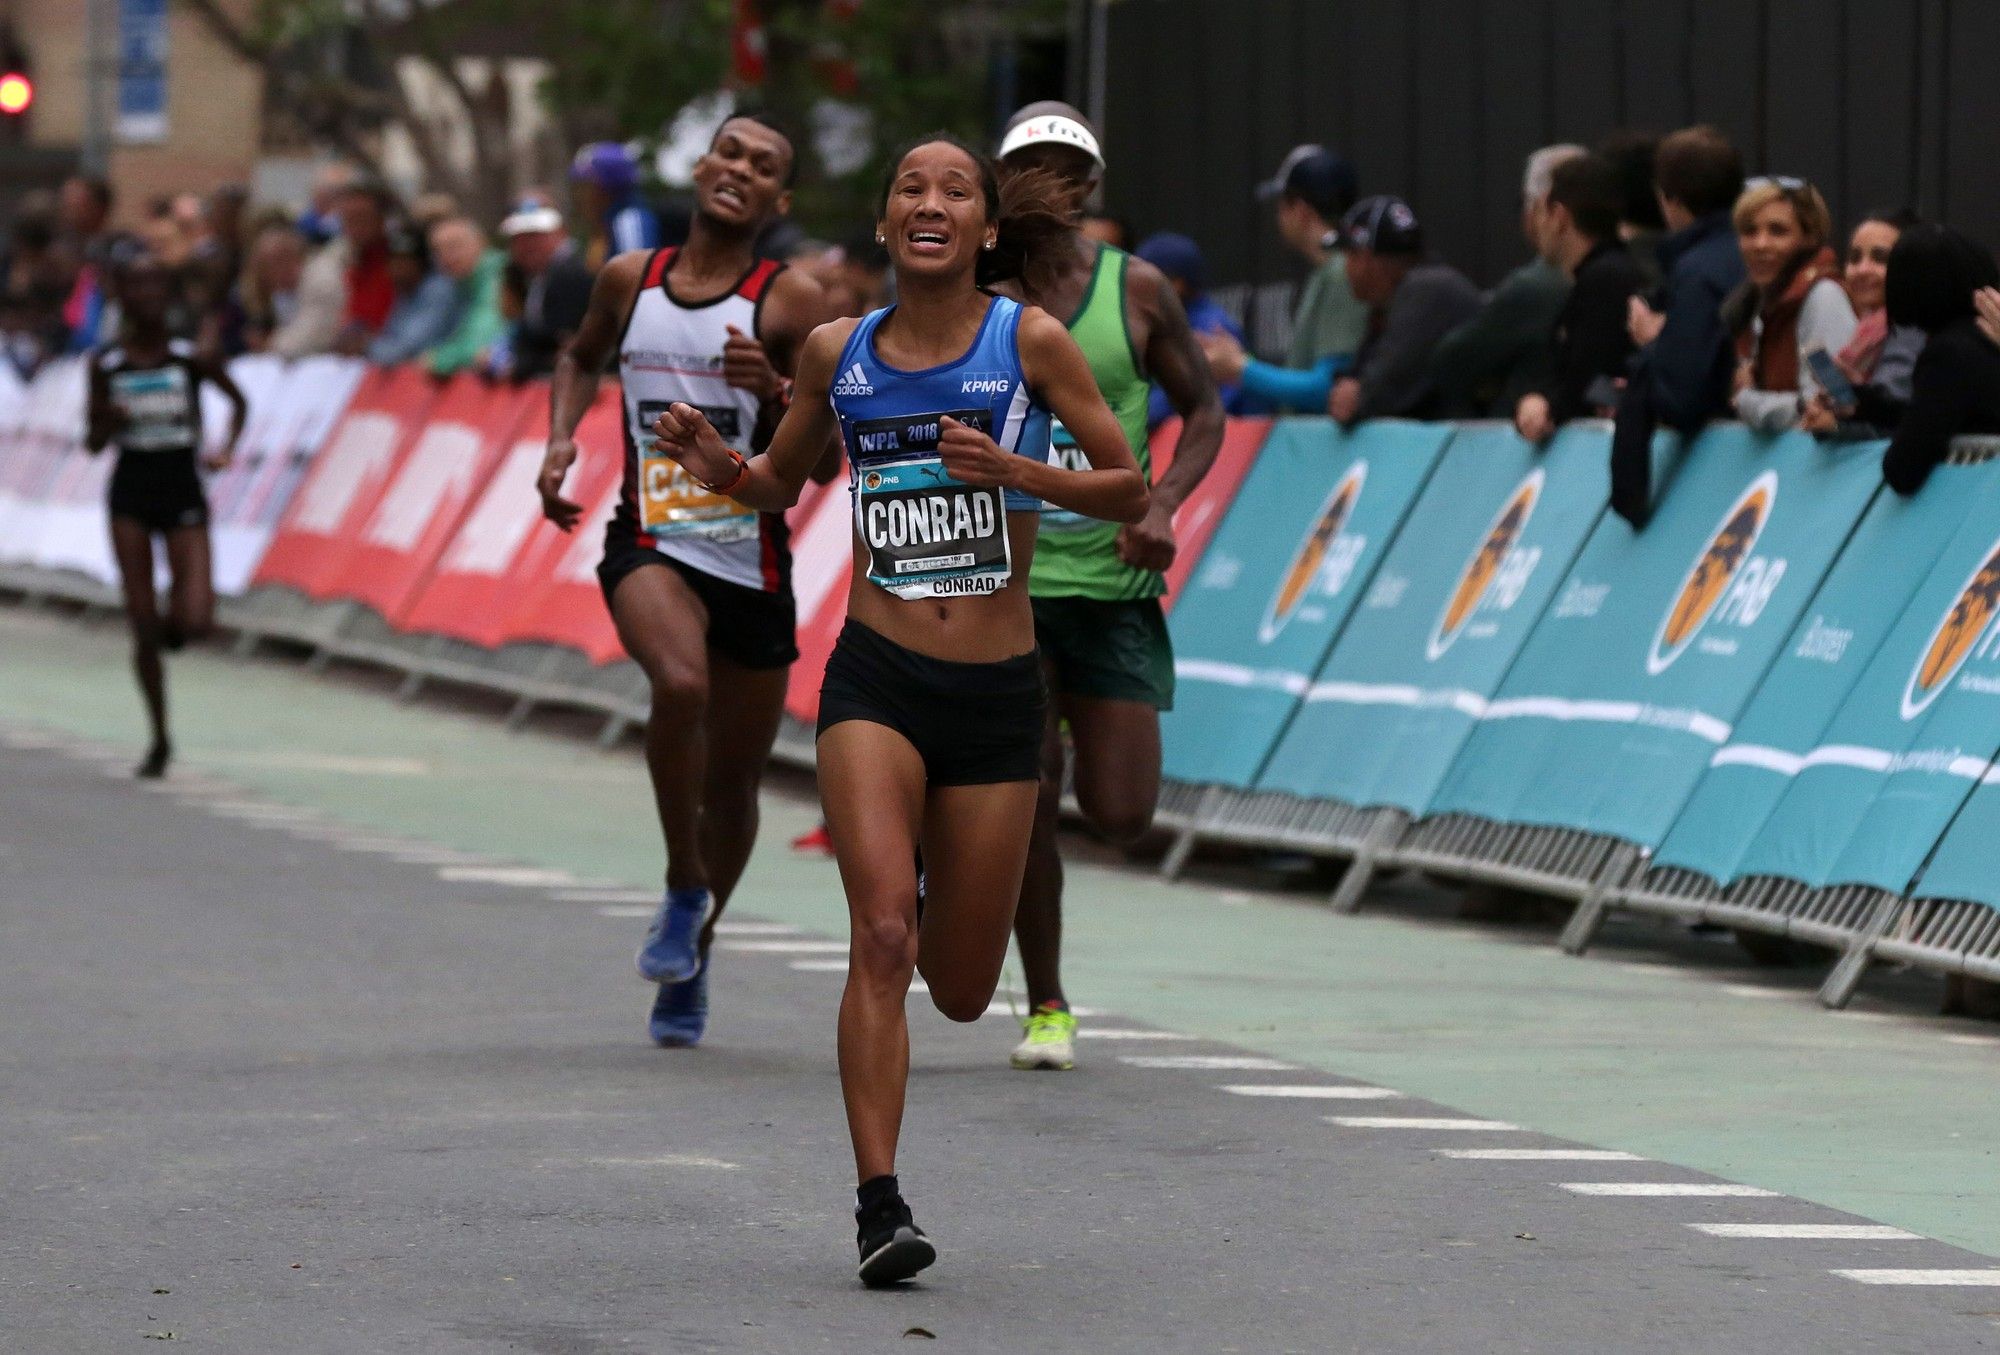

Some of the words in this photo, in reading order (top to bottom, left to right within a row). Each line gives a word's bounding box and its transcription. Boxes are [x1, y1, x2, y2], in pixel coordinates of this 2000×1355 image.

[834, 383, 874, 396] adidas
[961, 379, 1009, 393] KPMG
[859, 431, 899, 452] WPA
[907, 422, 938, 441] 2018
[882, 476, 900, 485] FNB
[868, 491, 995, 549] CONRAD
[933, 577, 996, 594] CONRAD
